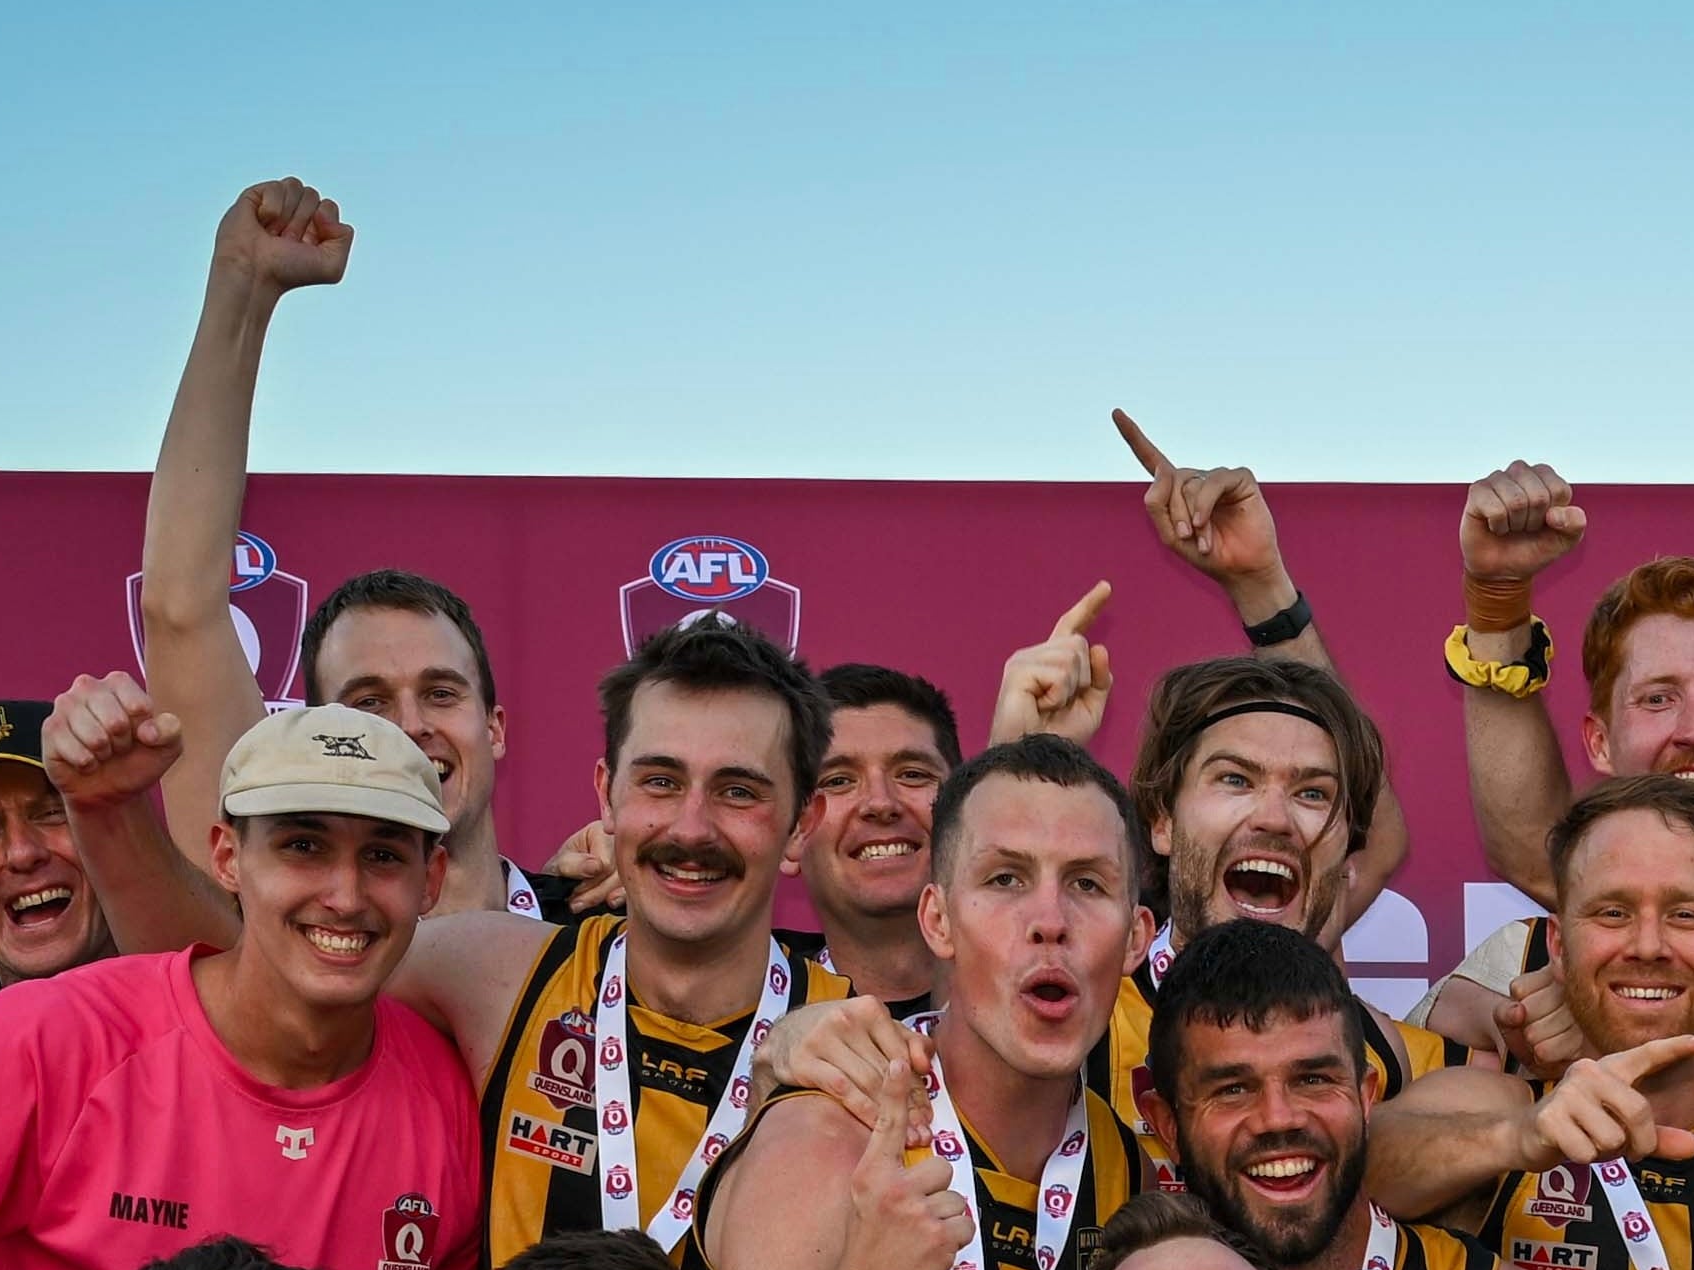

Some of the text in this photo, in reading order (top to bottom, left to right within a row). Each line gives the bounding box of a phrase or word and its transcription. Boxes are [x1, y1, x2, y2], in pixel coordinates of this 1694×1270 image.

[661, 551, 757, 584] AFL
[551, 1038, 586, 1086] Q
[534, 1076, 593, 1104] QUEENSLAND
[511, 1116, 594, 1155] HART
[533, 1145, 581, 1166] SPORT
[1540, 1165, 1576, 1201] Q
[1641, 1170, 1687, 1188] RF
[110, 1192, 189, 1230] MAYNE
[400, 1199, 429, 1215] AFL
[395, 1223, 424, 1262] Q
[1514, 1242, 1593, 1267] HART
